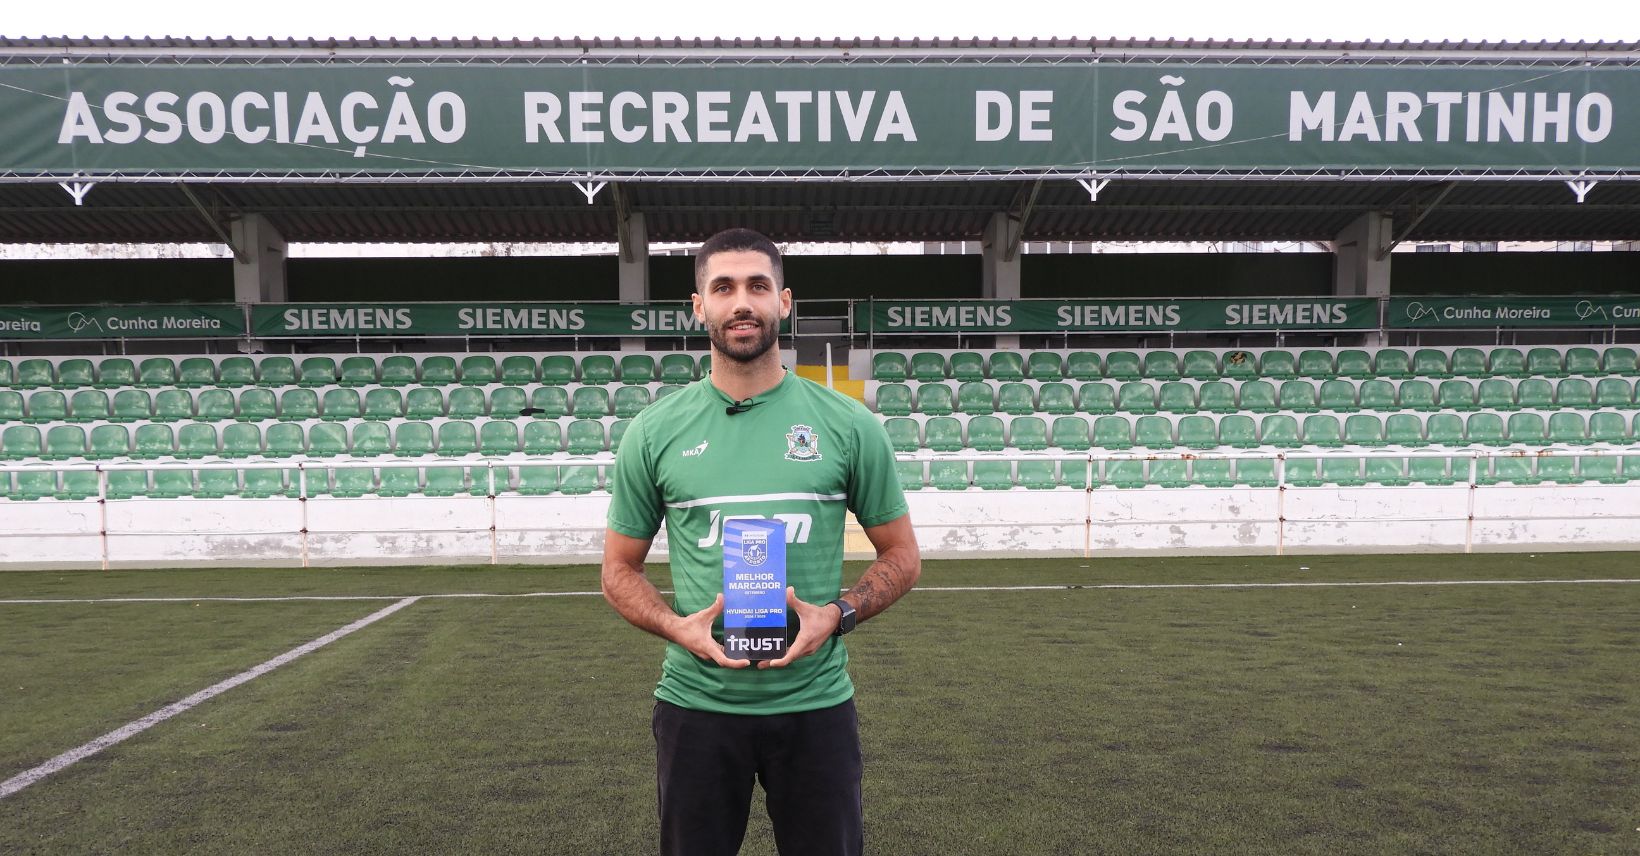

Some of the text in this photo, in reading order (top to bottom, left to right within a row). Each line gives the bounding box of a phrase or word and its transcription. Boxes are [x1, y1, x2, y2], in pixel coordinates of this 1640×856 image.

[58, 75, 1613, 157] ASSOCIAÇÃO RECREATIVA DE SÃO MARTINHO
[106, 315, 221, 330] Cunha Moreira
[283, 308, 413, 330] SIEMENS
[458, 307, 585, 330] SIEMENS
[631, 309, 706, 331] SIEM
[887, 305, 1012, 327] SIEMENS
[1057, 304, 1181, 327] SIEMENS
[1225, 303, 1348, 325] SIEMENS
[1443, 306, 1551, 319] Cunha Moreira
[728, 582, 781, 590] MARCADOR
[735, 573, 774, 581] MELHOR
[727, 635, 784, 651] TRUST
